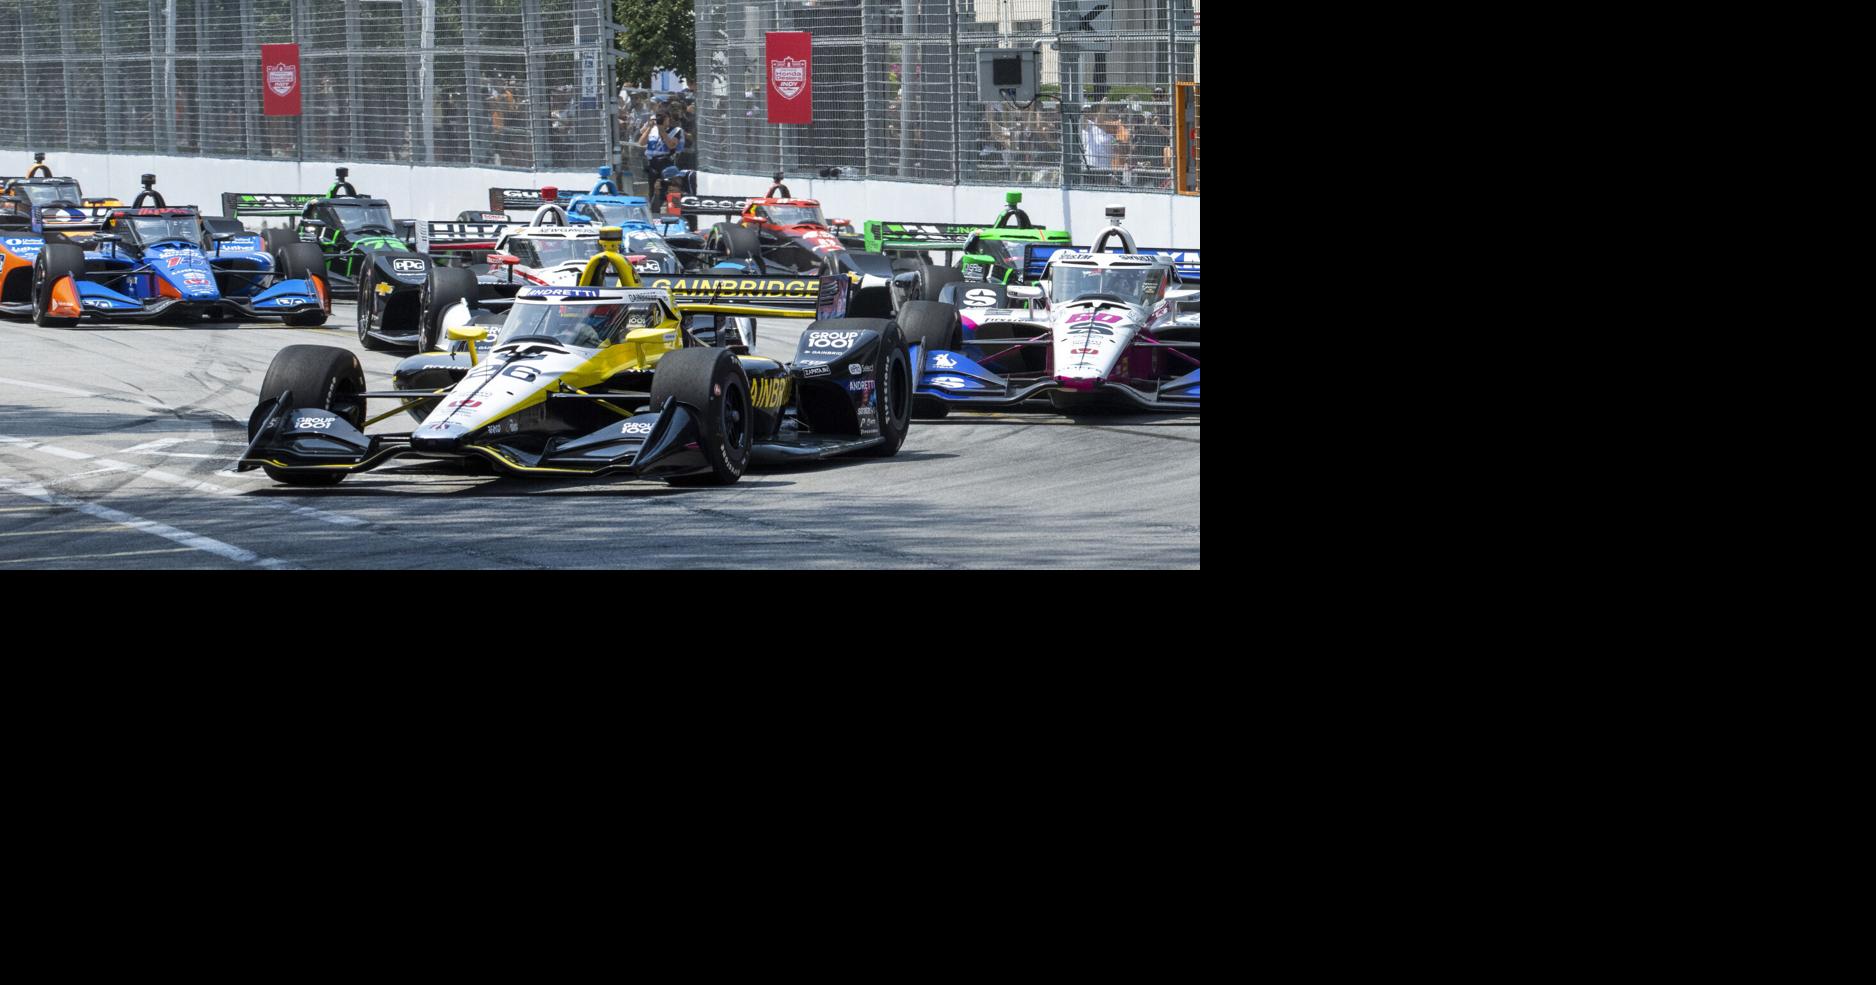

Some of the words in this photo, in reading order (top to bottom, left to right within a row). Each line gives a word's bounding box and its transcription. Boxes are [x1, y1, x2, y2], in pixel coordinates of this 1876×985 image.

[396, 261, 423, 270] PPG
[652, 278, 819, 298] GAINBRIDGE
[809, 331, 858, 340] GROUP
[808, 339, 854, 348] 1001
